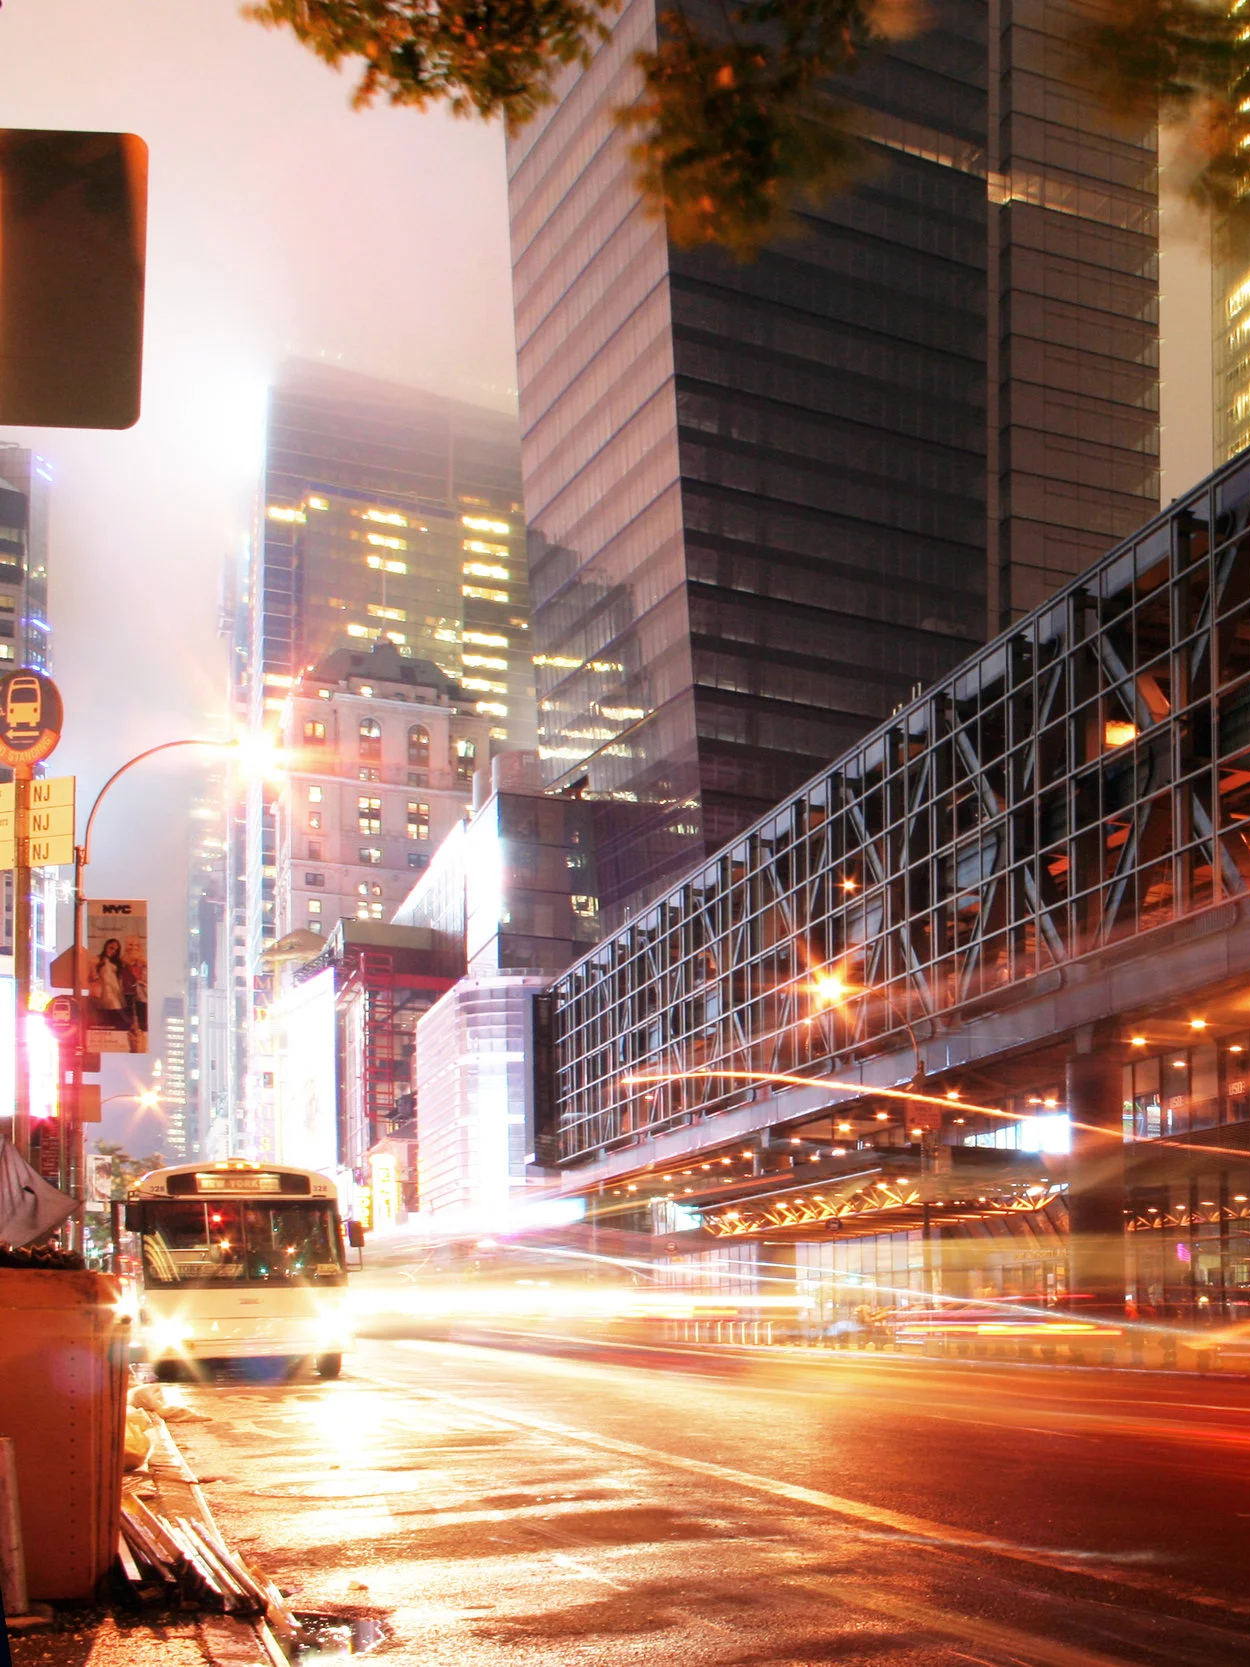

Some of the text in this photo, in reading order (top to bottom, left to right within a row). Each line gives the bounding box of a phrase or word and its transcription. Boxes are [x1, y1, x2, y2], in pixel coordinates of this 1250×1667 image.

[8, 736, 53, 762] STANDING
[33, 784, 51, 802] NJ
[32, 813, 50, 832] NJ
[32, 843, 49, 861] NJ
[102, 904, 132, 914] NYC
[1228, 1081, 1243, 1096] USO
[230, 1179, 259, 1188] YORK
